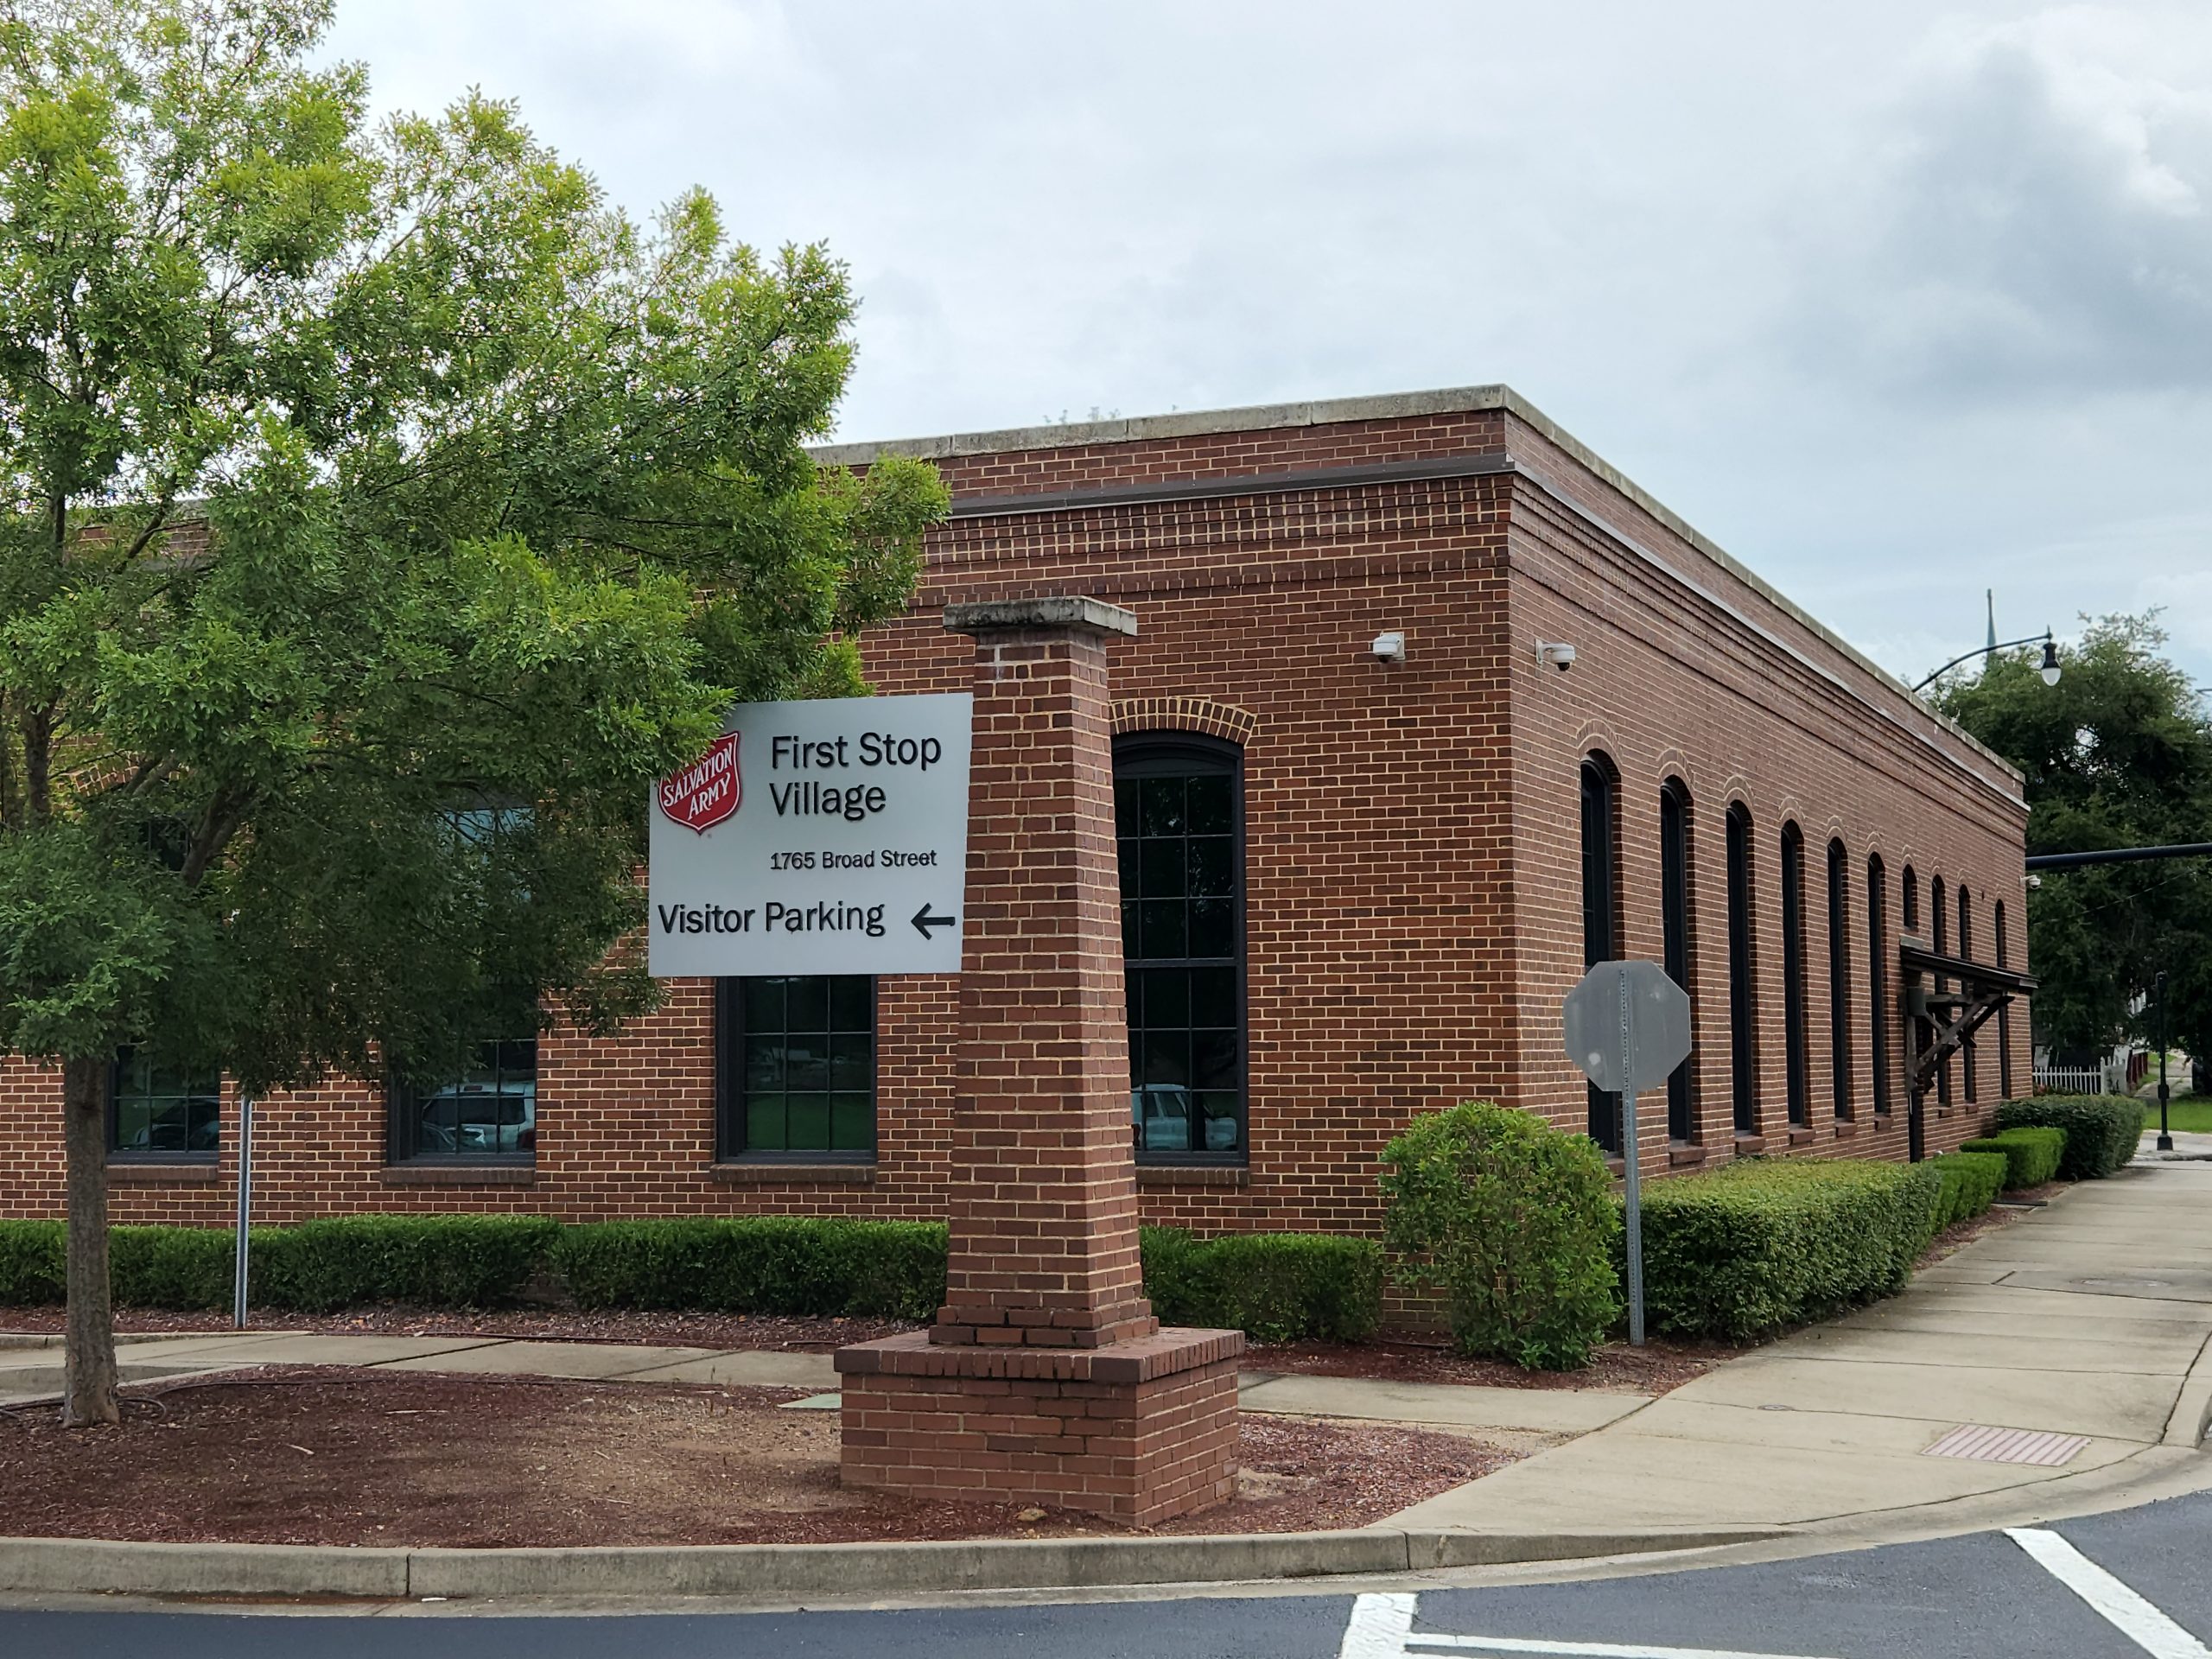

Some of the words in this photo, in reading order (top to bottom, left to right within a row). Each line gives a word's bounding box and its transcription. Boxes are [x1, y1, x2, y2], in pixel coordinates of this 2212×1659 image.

[772, 734, 849, 770] First
[859, 732, 942, 771] Stop
[664, 742, 732, 807] SALVATION
[688, 772, 730, 821] ARMY
[769, 781, 887, 822] Village
[770, 852, 816, 870] 1765
[822, 850, 875, 869] Broad
[880, 849, 938, 867] Street
[658, 904, 756, 934] Visitor
[765, 900, 887, 937] Parking
